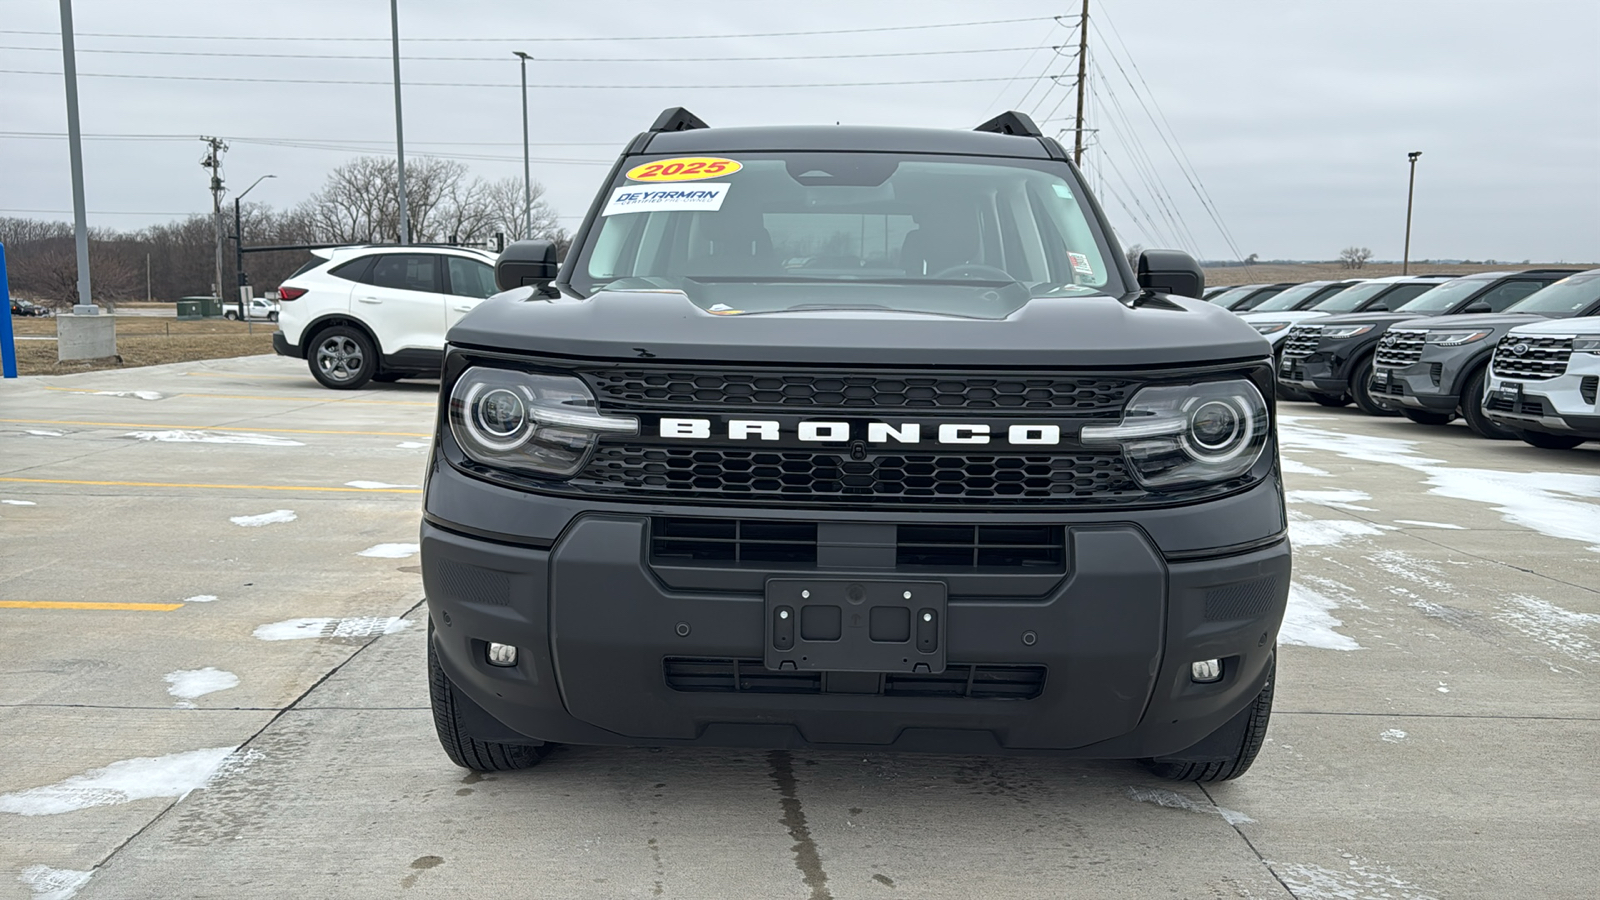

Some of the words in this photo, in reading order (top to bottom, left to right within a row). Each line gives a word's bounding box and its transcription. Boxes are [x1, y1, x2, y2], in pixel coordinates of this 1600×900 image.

[637, 161, 730, 178] 2025
[615, 191, 720, 202] DEYARMAN
[660, 418, 1060, 445] BRONCO
